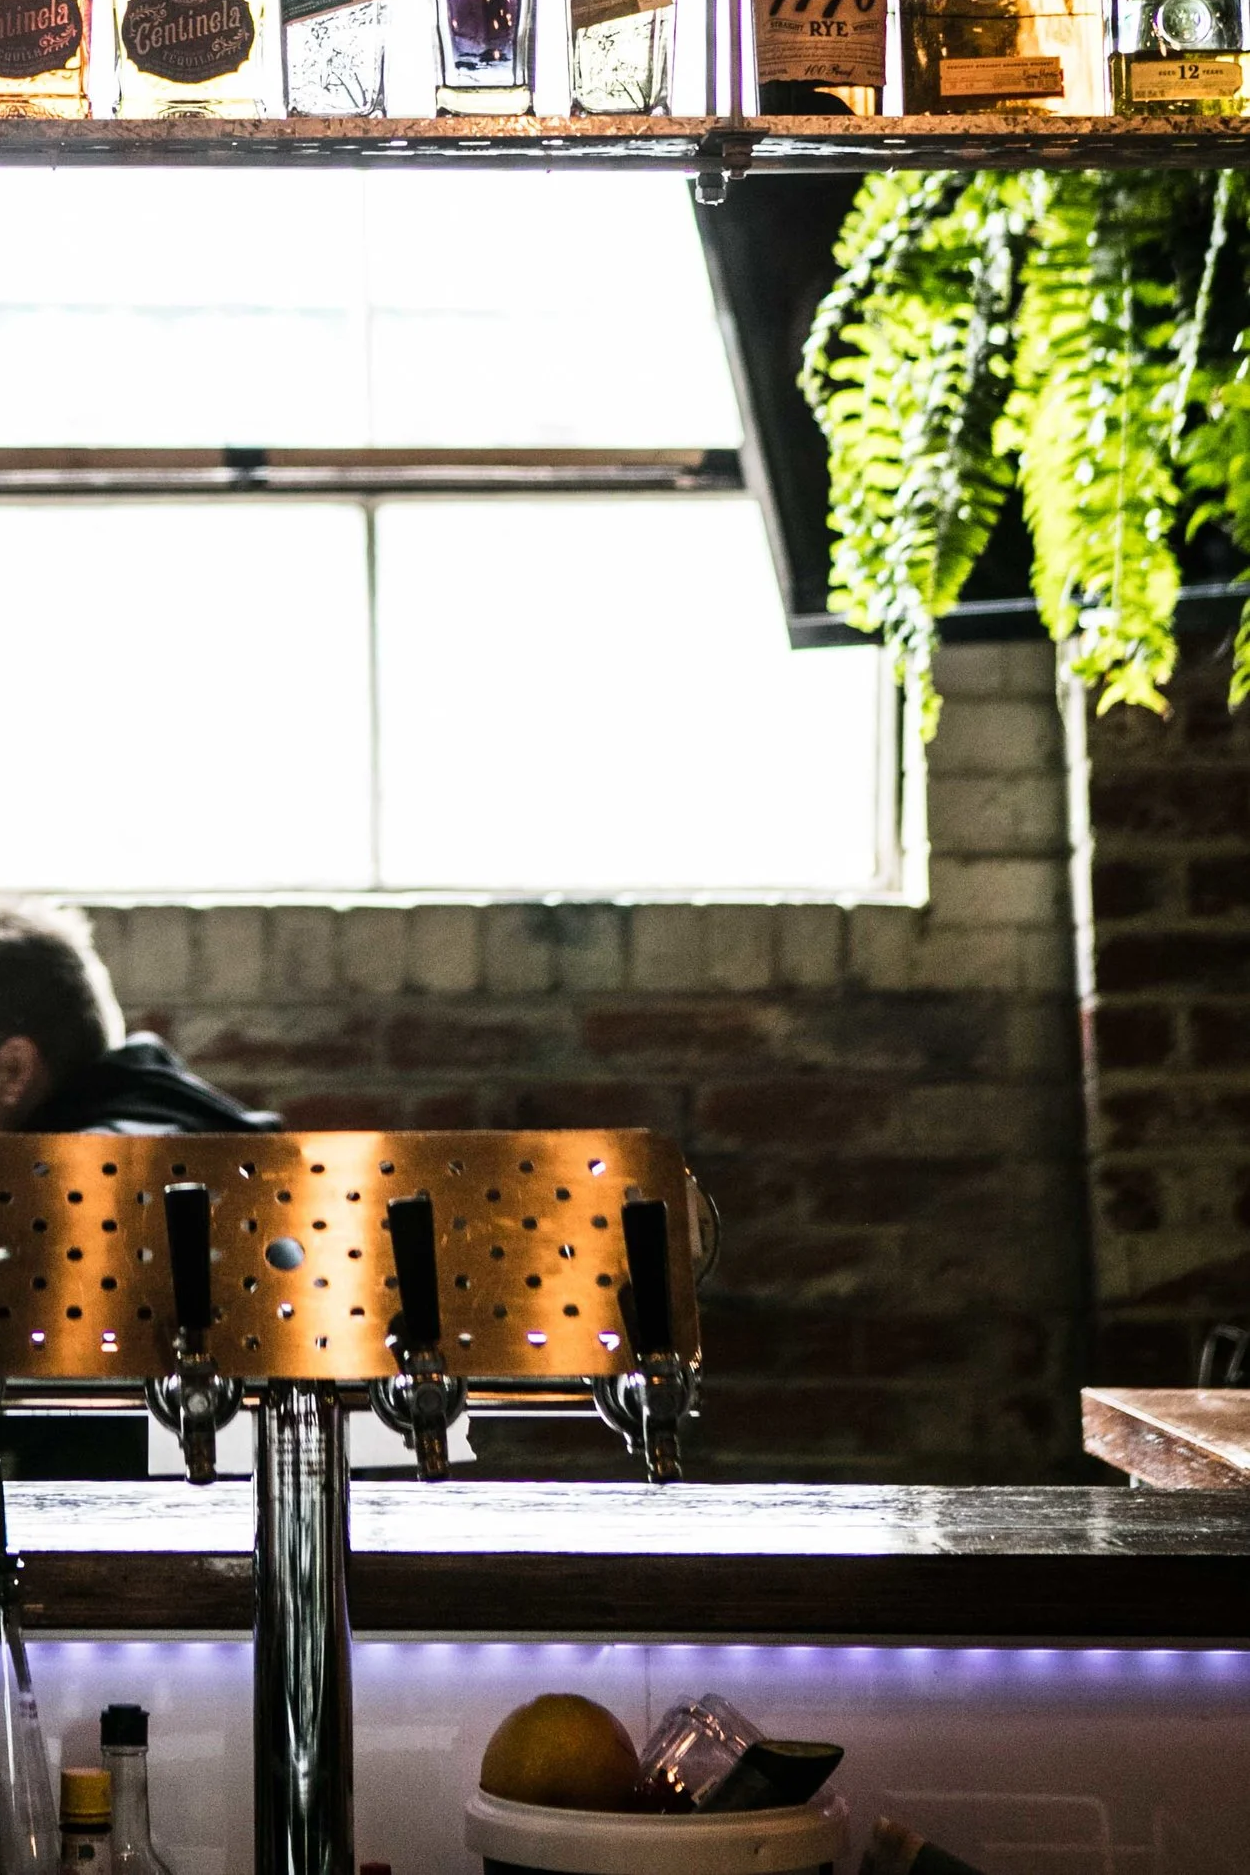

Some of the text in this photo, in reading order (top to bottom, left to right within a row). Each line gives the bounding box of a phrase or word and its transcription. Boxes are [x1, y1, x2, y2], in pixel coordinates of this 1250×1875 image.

[135, 0, 241, 56] Centinela
[809, 21, 849, 38] RYE
[1178, 64, 1200, 80] 12
